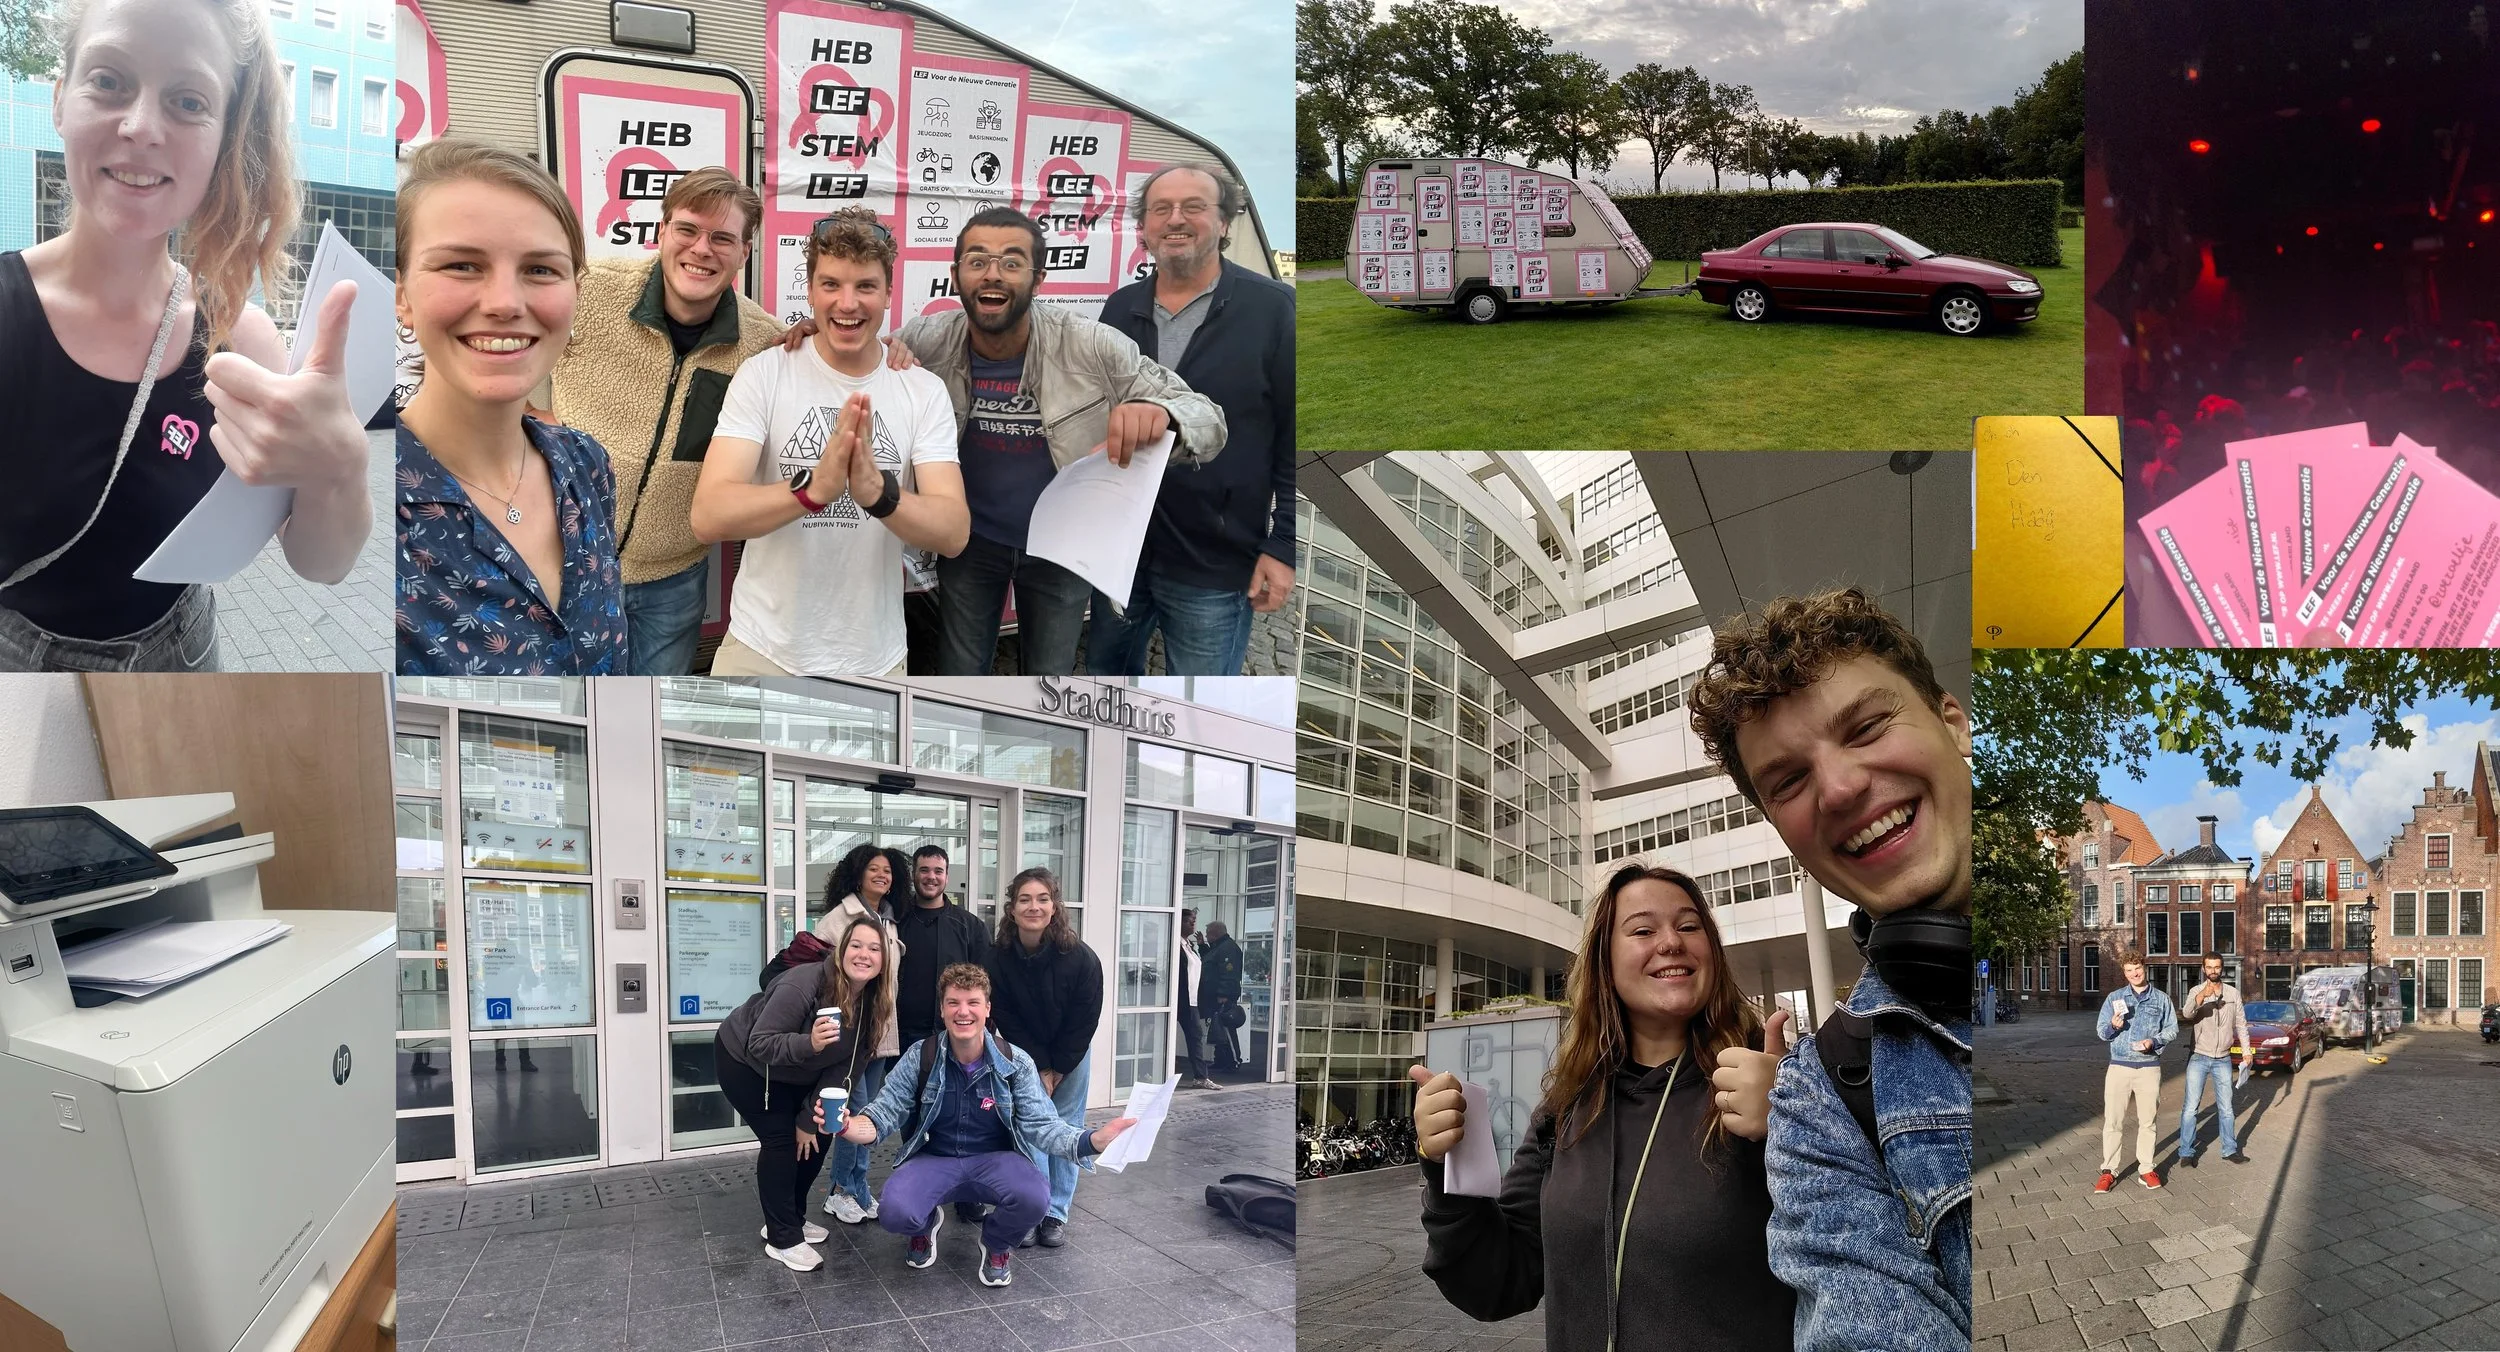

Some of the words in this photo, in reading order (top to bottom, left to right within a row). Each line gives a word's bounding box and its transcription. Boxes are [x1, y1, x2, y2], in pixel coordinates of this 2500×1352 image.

[810, 38, 873, 65] HEB
[930, 73, 946, 81] Voor
[959, 76, 984, 85] Nieuwe
[984, 79, 1017, 88] Generatie
[813, 87, 867, 112] LEF
[618, 120, 692, 147] HEB
[800, 134, 879, 158] STEM
[917, 130, 952, 138] JEUGDZORG
[1049, 136, 1099, 156] HEB
[811, 177, 865, 197] LEF
[1050, 177, 1091, 195] LEF
[610, 220, 660, 246] ST
[1037, 214, 1099, 232] STEM
[1044, 248, 1085, 269] LEF
[976, 380, 1018, 394] INTAGE
[2240, 460, 2256, 518] Generatie
[2302, 466, 2312, 526] Generatie
[802, 521, 834, 529] NUBIYAN
[835, 522, 859, 530] TWIST
[2301, 596, 2317, 620] LEF
[2318, 566, 2338, 592] Voor
[2336, 549, 2348, 566] de
[2343, 511, 2374, 552] Nieuwe
[2370, 458, 2407, 511] Generatie
[2160, 528, 2193, 582] Generatie
[2250, 520, 2264, 566] Nieuwe
[2302, 529, 2312, 576] Nieuwe
[2346, 592, 2364, 621] Voor
[2361, 577, 2374, 594] de
[2368, 534, 2394, 578] Nieuwe
[2389, 476, 2421, 534] Generatie
[2256, 570, 2266, 585] de
[2190, 582, 2216, 624] Nieuwe
[2259, 586, 2270, 617] Voor
[2384, 560, 2420, 630] @LEFNEDERLAND
[2448, 602, 2459, 620] HET
[2456, 592, 2464, 602] IS
[2460, 572, 2474, 592] HEEL
[2448, 619, 2460, 637] HET
[2457, 597, 2470, 618] HART
[2467, 580, 2480, 597] DAT
[2476, 562, 2488, 580] MEN
[2370, 610, 2378, 623] OP
[2398, 626, 2408, 640] 06
[2404, 617, 2412, 630] 30
[2409, 606, 2418, 618] 40
[2415, 594, 2424, 606] 42
[2420, 583, 2428, 595] 00
[2214, 624, 2226, 640] de
[1040, 676, 1175, 736] Stadhuis
[335, 1045, 350, 1085] hp
[1471, 1044, 1484, 1064] P
